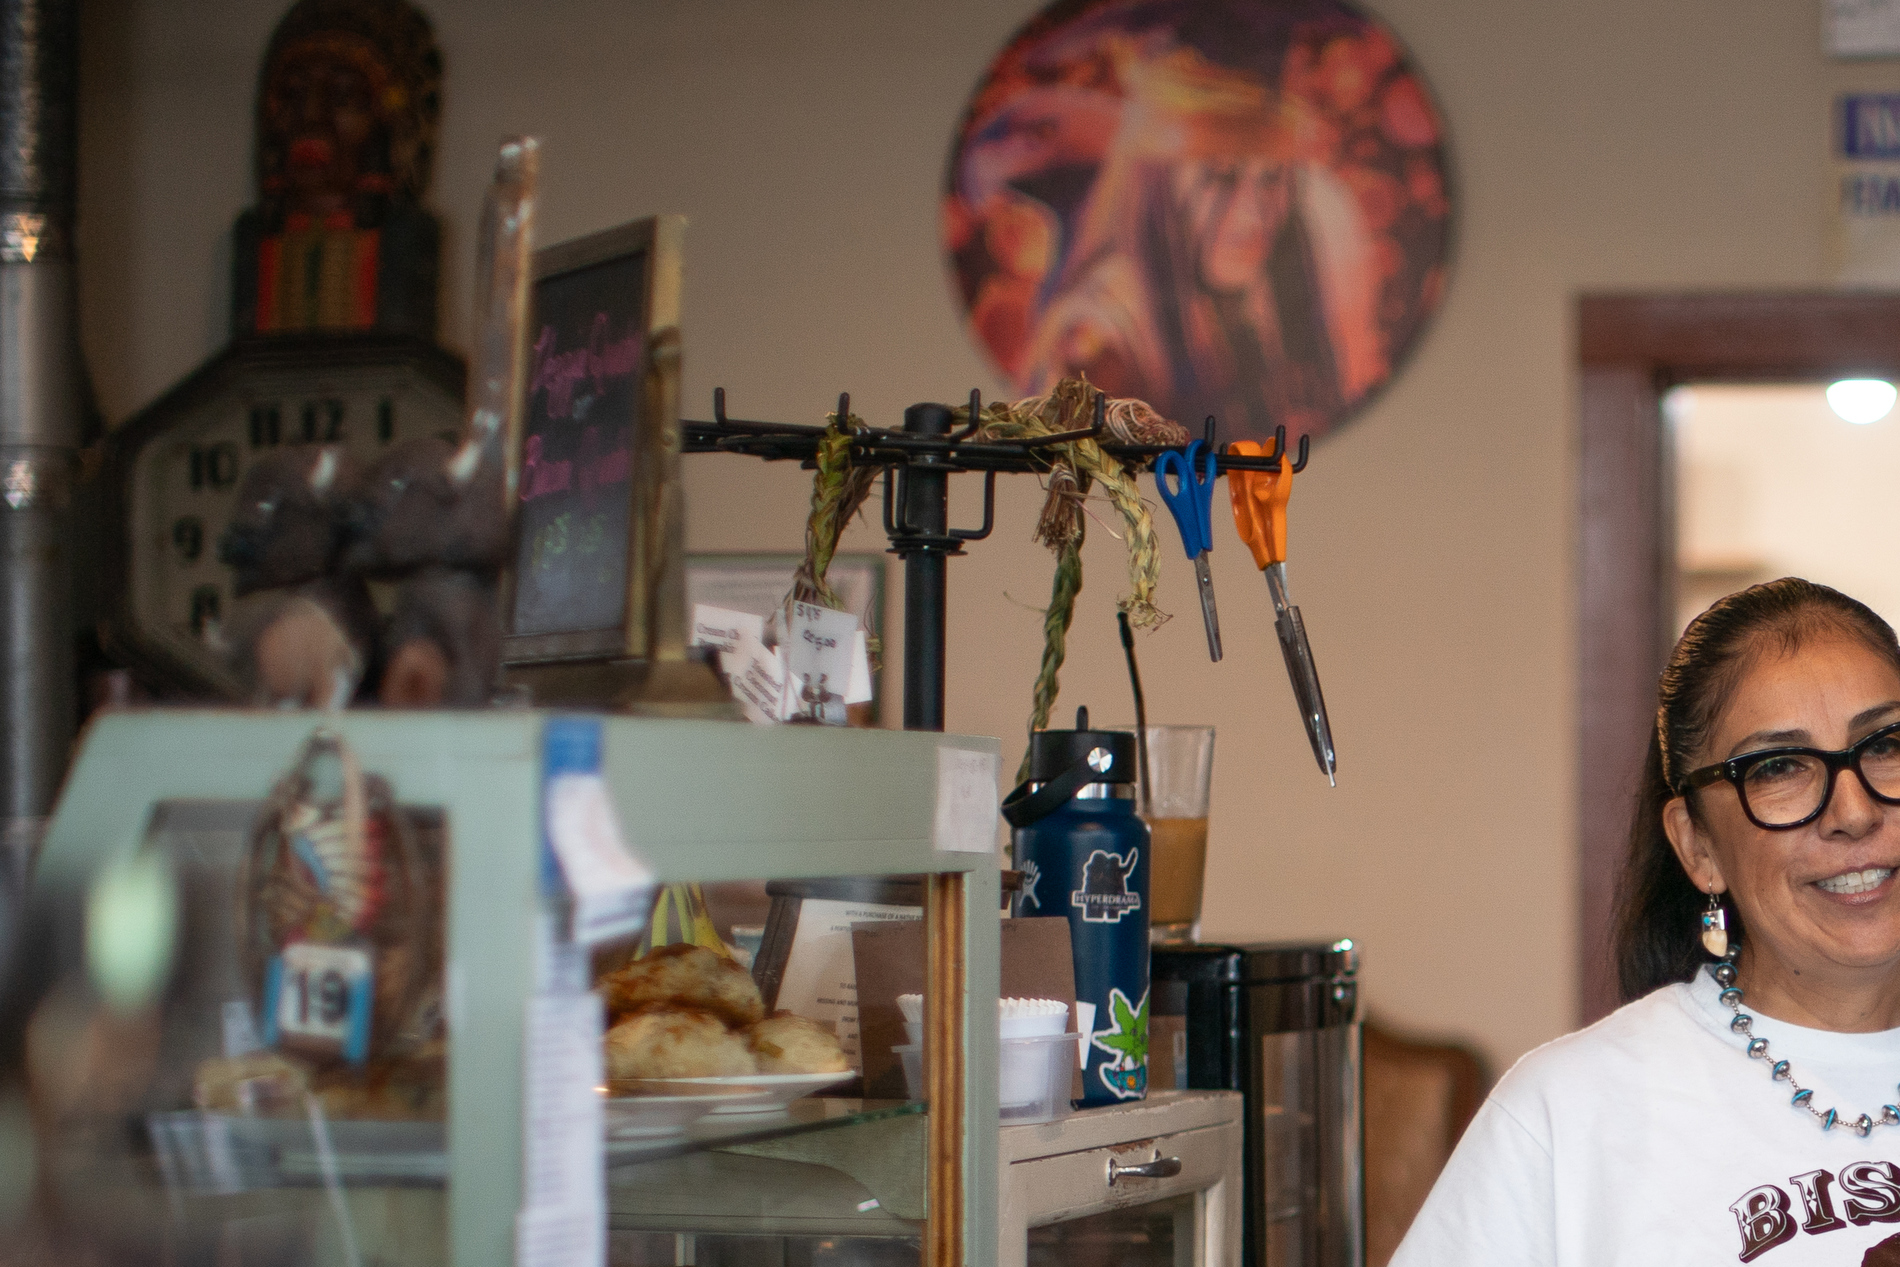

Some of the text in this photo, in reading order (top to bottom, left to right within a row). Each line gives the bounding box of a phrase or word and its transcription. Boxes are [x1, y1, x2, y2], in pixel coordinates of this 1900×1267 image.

[301, 399, 344, 442] 12
[189, 447, 239, 491] 10
[173, 515, 203, 564] 9
[1075, 894, 1139, 905] HYPERDRAMA
[294, 967, 352, 1025] 19
